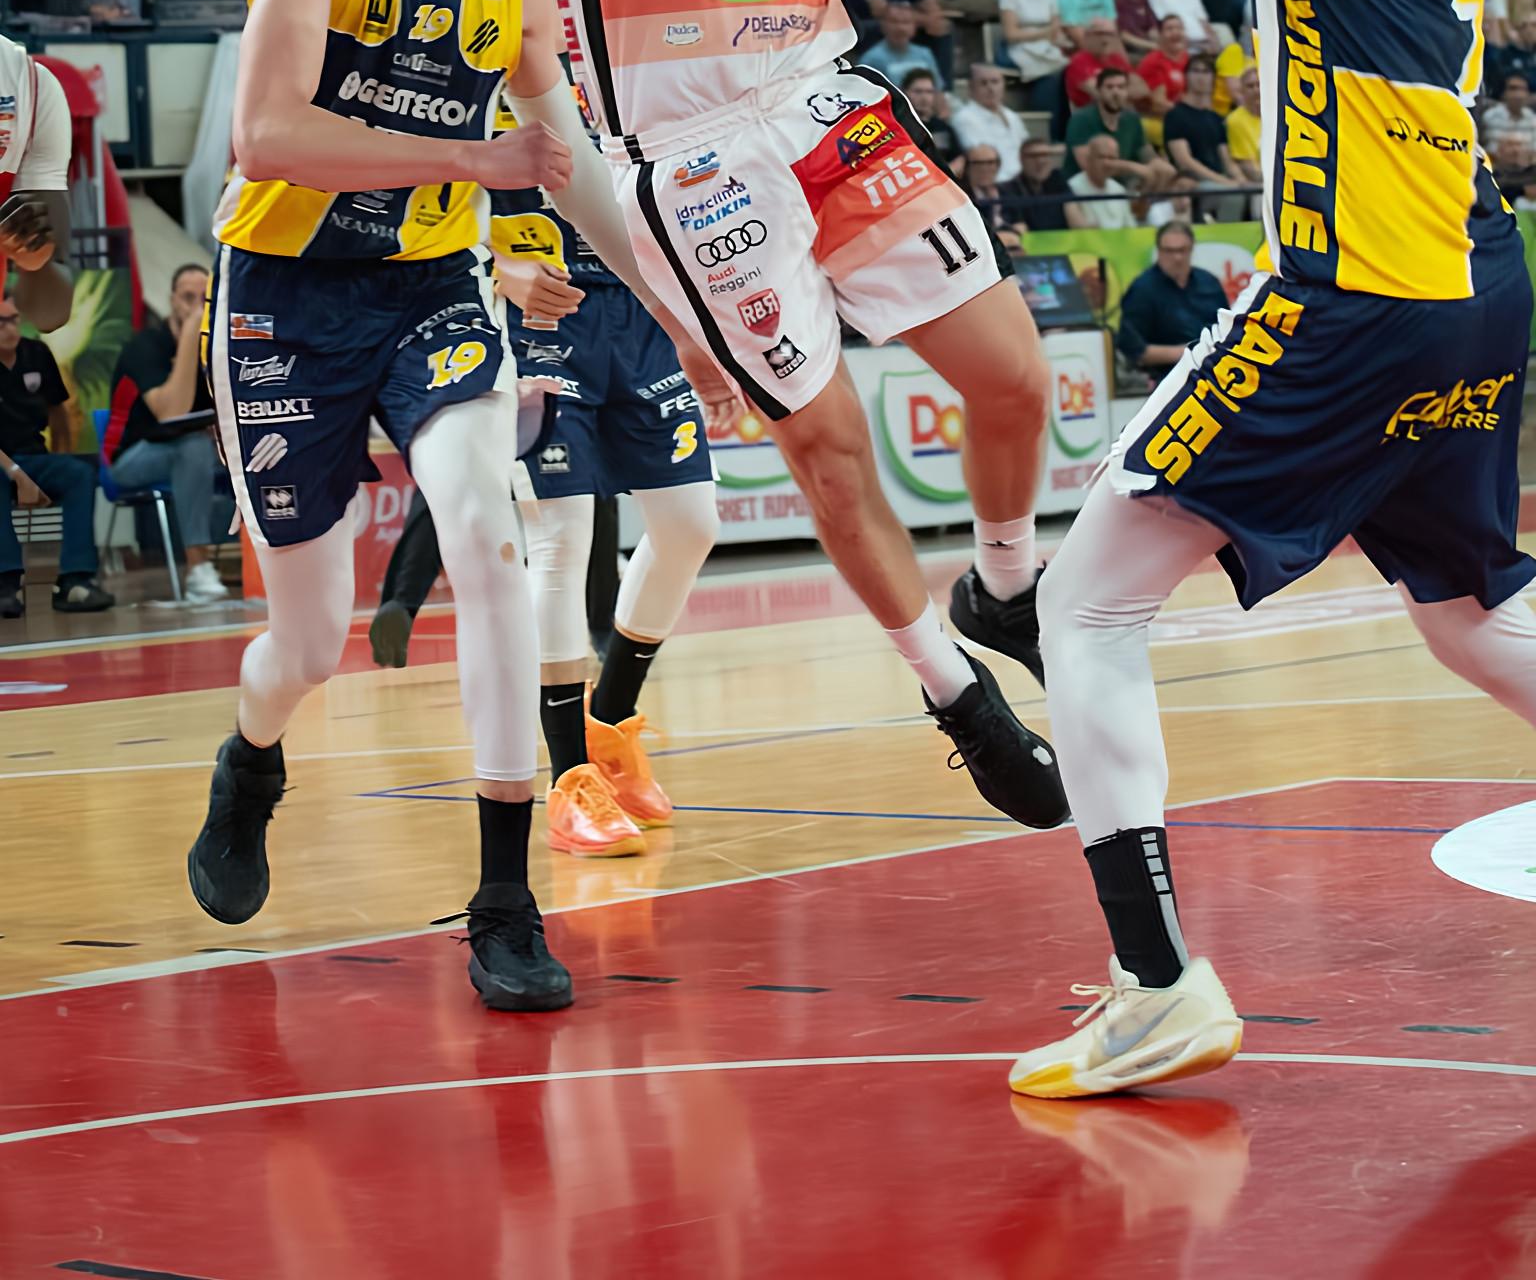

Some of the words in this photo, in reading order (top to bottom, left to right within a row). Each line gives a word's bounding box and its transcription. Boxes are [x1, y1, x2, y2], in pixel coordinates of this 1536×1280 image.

[408, 4, 454, 43] 19
[862, 151, 930, 208] nts
[693, 194, 751, 231] DAIKIN
[918, 215, 981, 277] 11
[707, 264, 737, 283] Audi
[426, 341, 488, 390] 19
[1144, 291, 1305, 486] EAGLES
[671, 420, 698, 464] 3
[908, 393, 964, 448] Do
